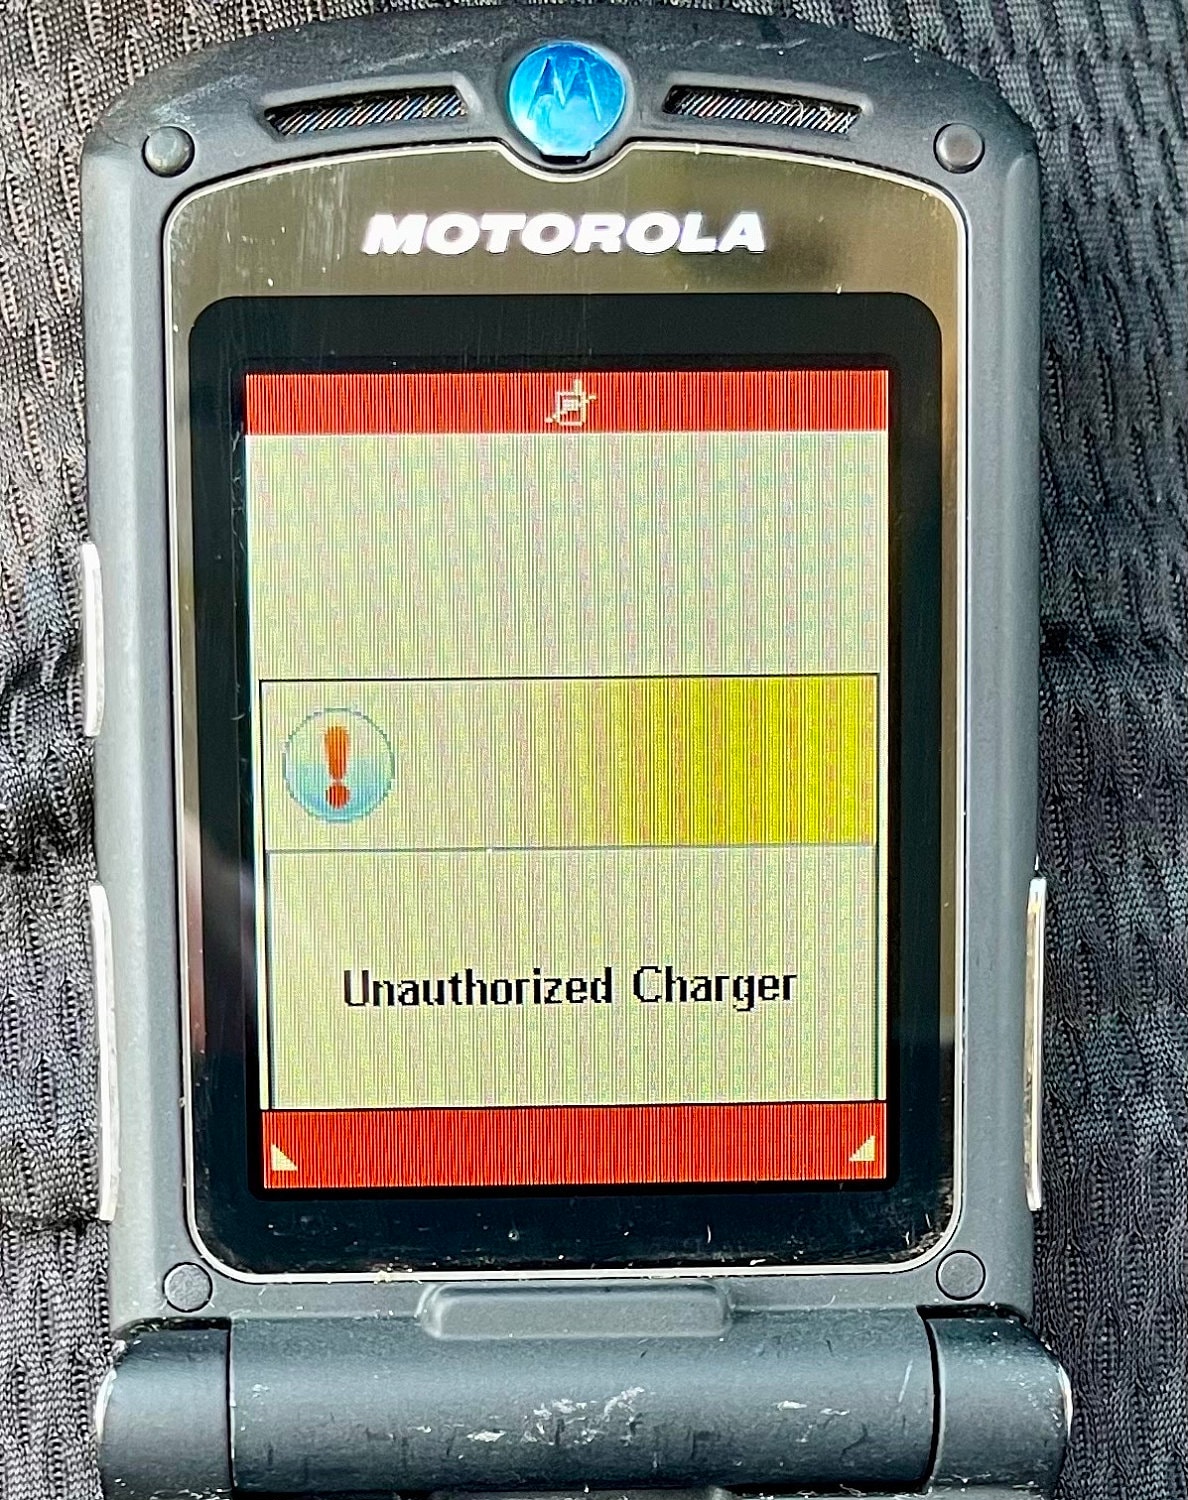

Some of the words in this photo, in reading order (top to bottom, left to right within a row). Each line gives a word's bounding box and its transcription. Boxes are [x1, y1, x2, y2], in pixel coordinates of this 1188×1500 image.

[362, 211, 765, 254] MOTOROLA
[342, 967, 613, 1008] Unauthorized
[632, 965, 798, 1012] Charger
